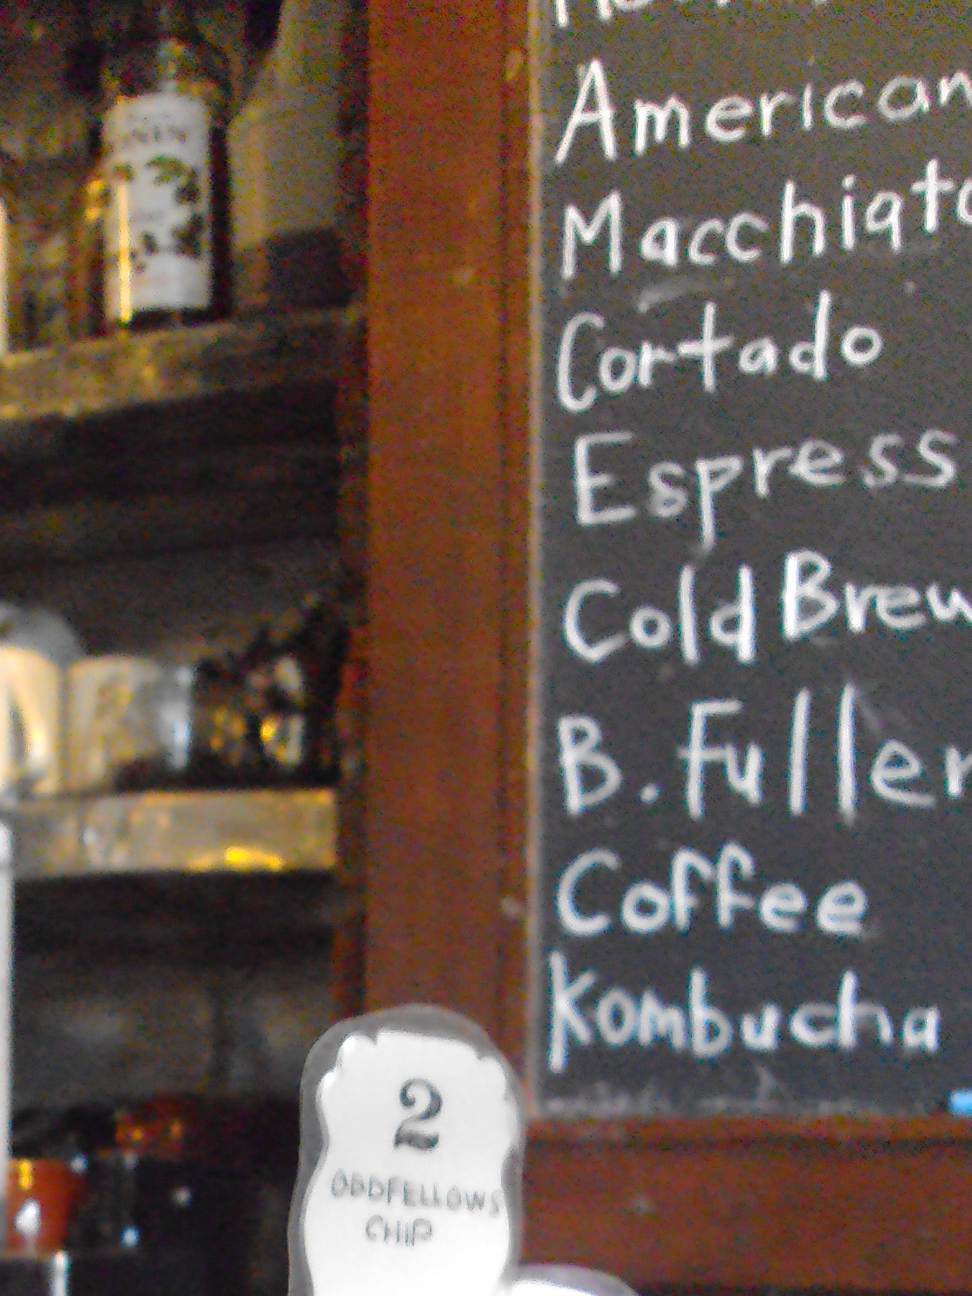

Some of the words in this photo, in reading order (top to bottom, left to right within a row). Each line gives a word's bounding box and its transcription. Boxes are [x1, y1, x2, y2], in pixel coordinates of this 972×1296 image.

[557, 290, 883, 413] Cortado
[573, 428, 958, 550] Espress
[563, 563, 755, 665] Cold
[556, 841, 870, 938] Coffee
[548, 950, 940, 1074] Kombucha
[393, 1077, 443, 1153] 2
[330, 1168, 504, 1217] ODDFELLOWS
[365, 1214, 433, 1247] CHIP
